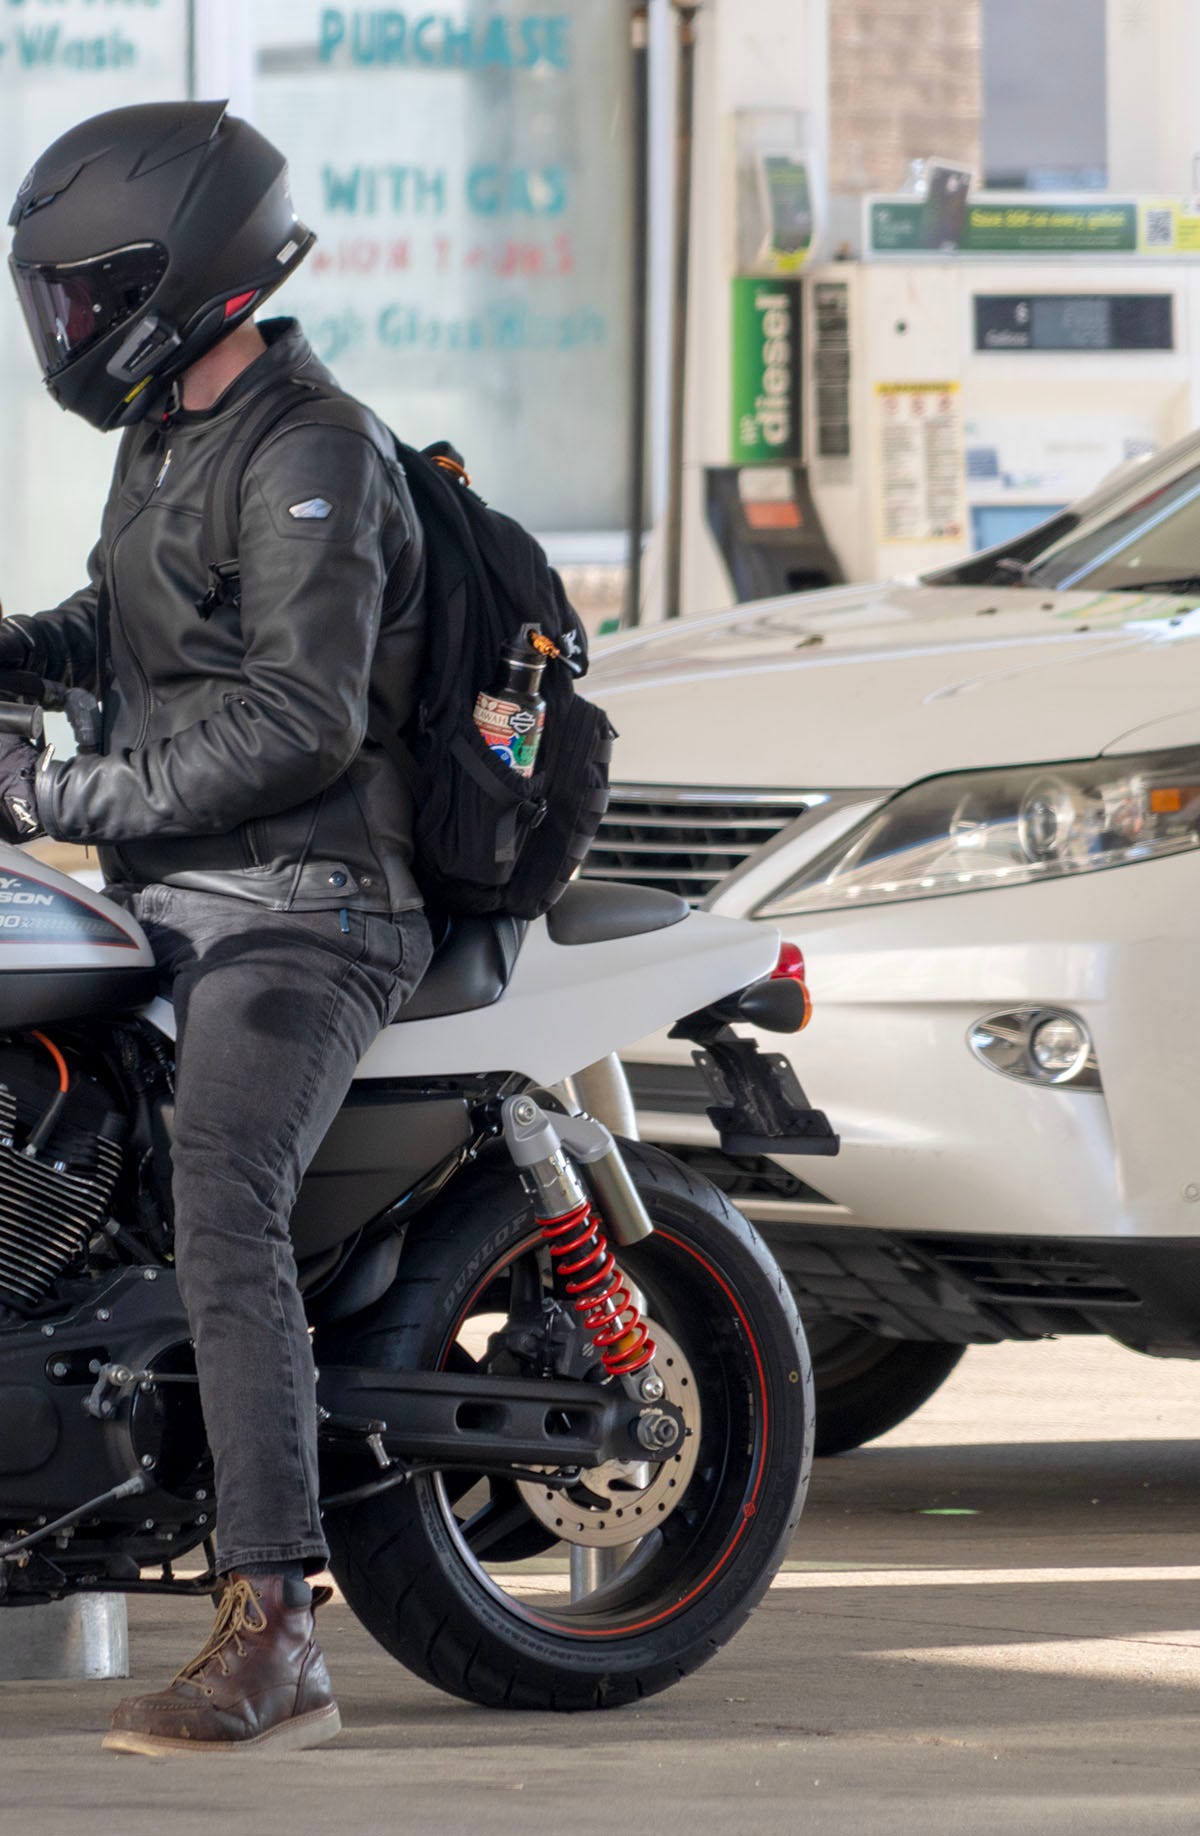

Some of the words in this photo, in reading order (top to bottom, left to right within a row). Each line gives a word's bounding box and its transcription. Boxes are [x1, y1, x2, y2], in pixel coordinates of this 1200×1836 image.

[16, 22, 137, 72] Wash
[317, 8, 568, 70] PURCHASE
[320, 163, 447, 216] WITH
[465, 163, 568, 216] GAS
[754, 292, 791, 445] diesel
[443, 1211, 530, 1312] DUNLOP
